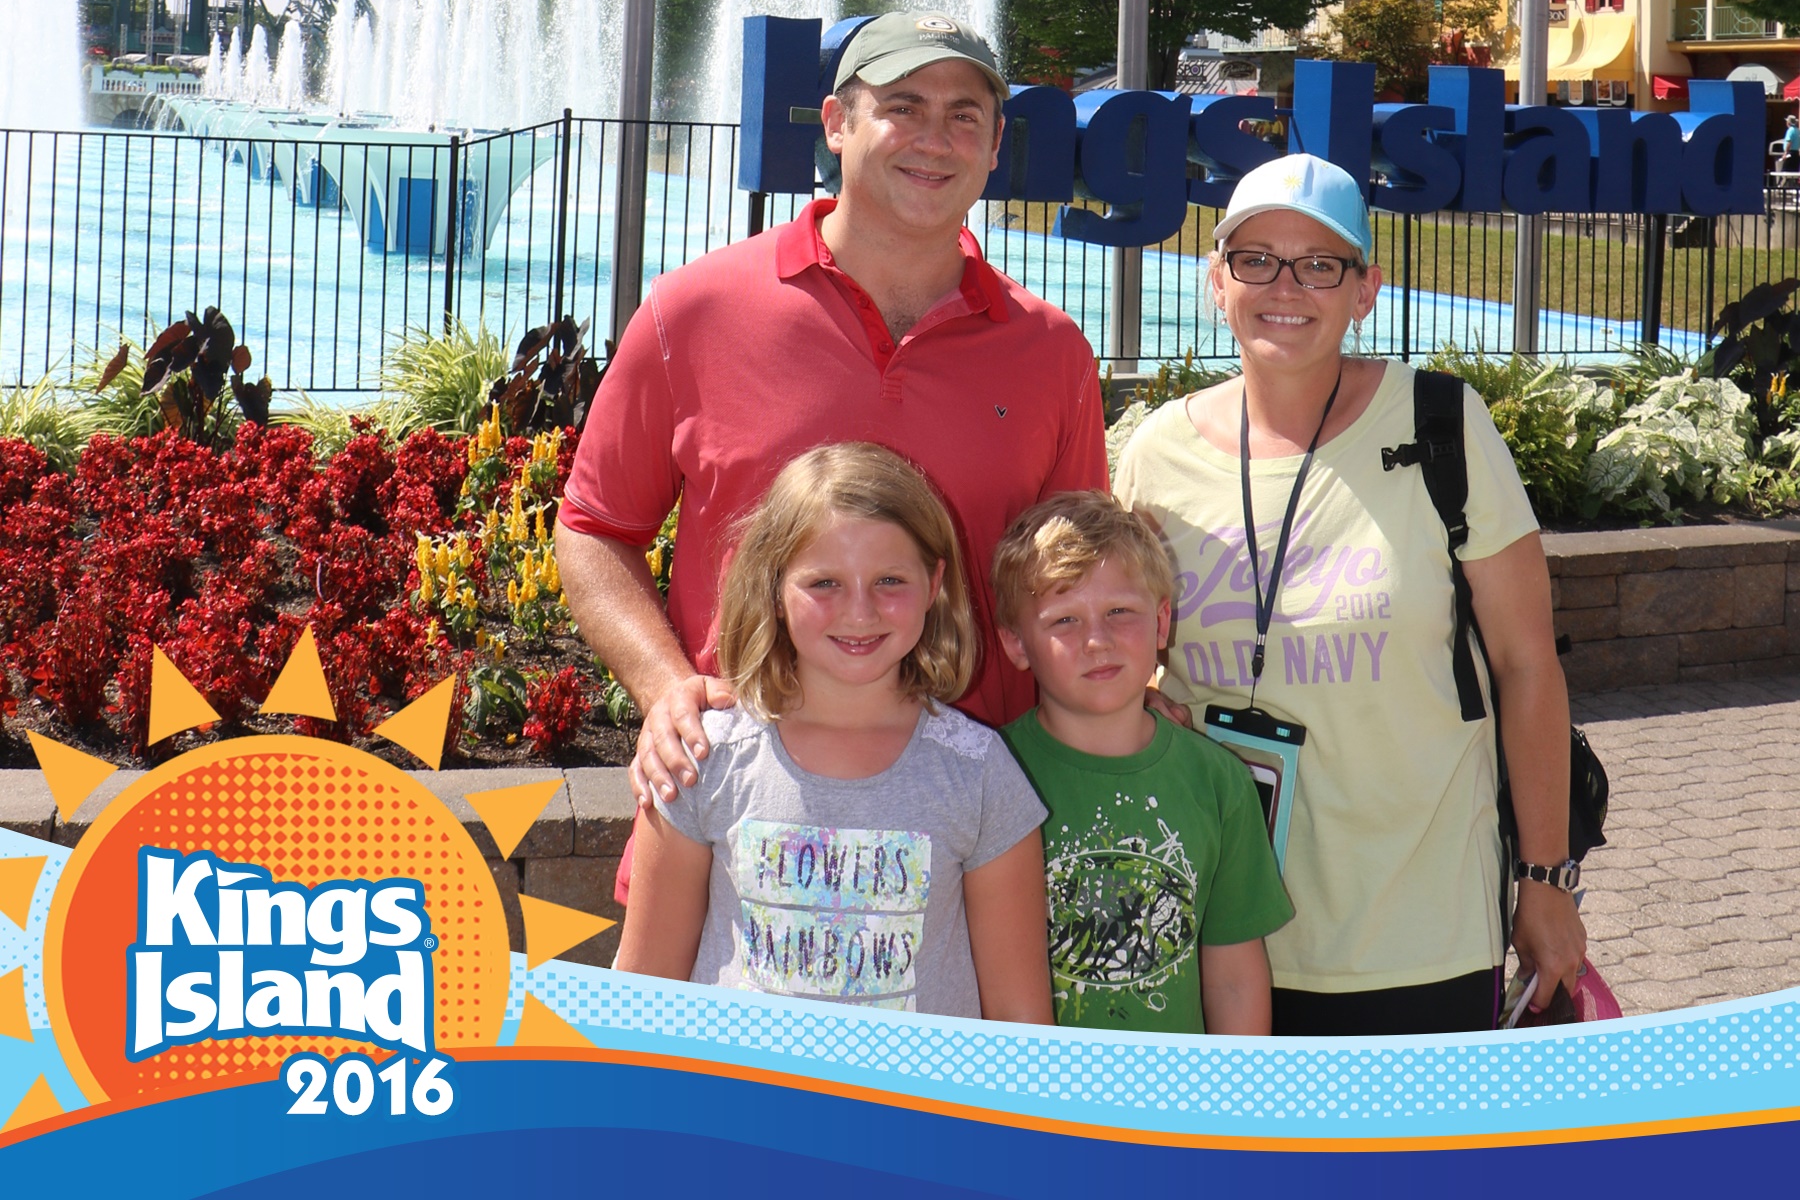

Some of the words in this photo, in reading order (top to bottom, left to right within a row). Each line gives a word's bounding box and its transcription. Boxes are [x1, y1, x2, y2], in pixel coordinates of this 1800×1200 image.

[738, 13, 1284, 248] Kngs
[1288, 59, 1766, 218] Island
[1334, 591, 1392, 622] 2012
[1182, 639, 1262, 687] OLD
[1281, 631, 1389, 686] NAVY
[758, 838, 910, 896] FLOWERS
[747, 915, 915, 980] RAINBOWS
